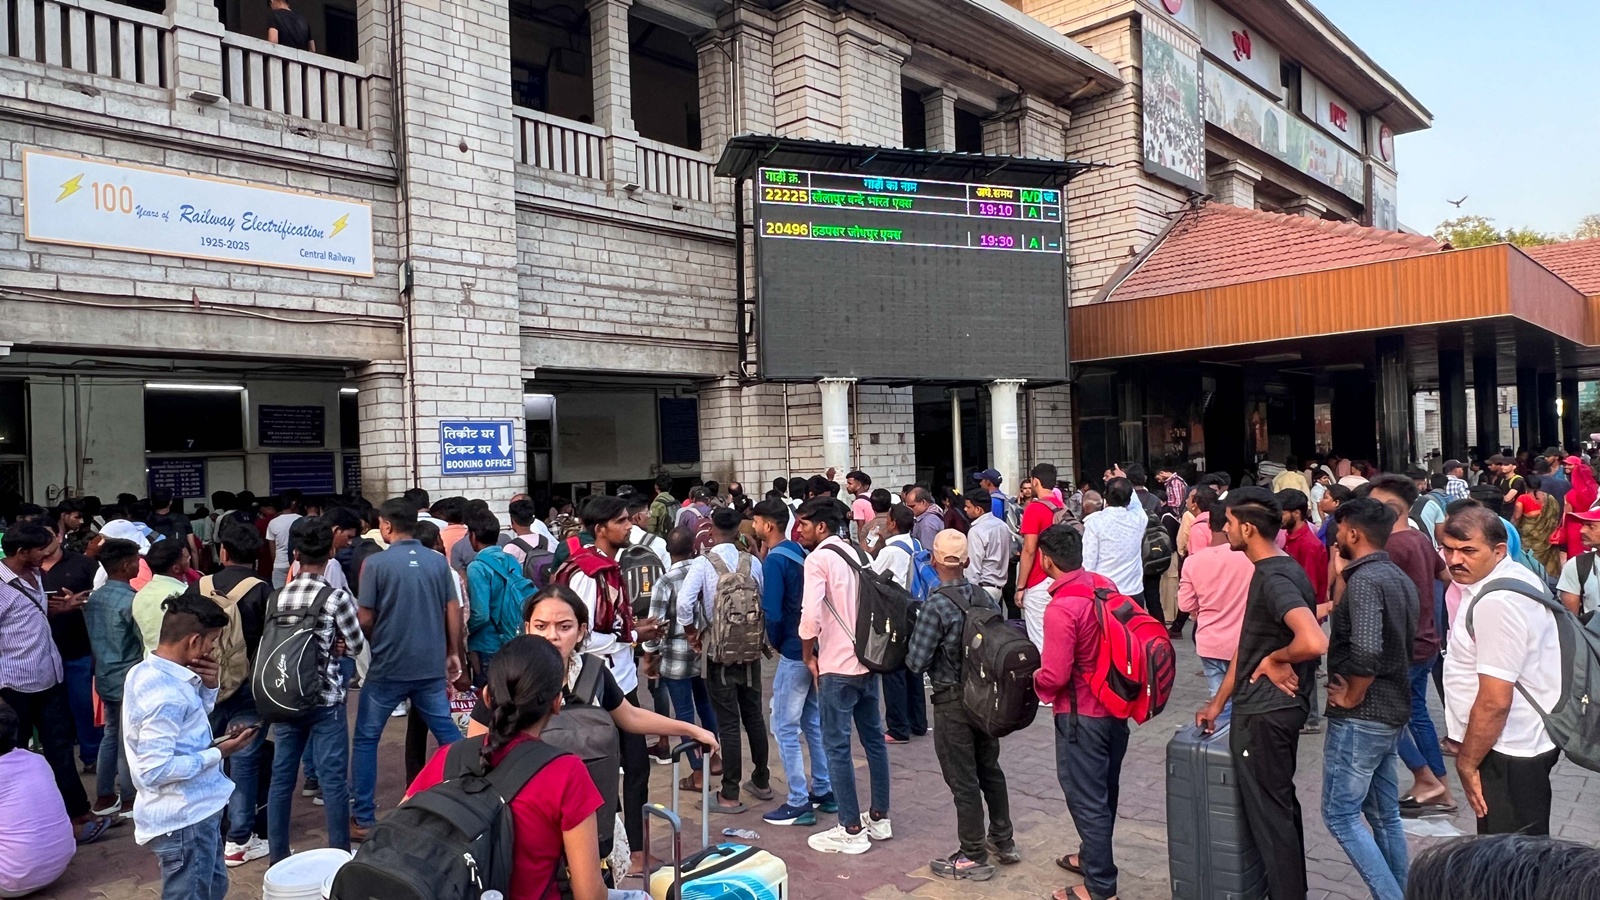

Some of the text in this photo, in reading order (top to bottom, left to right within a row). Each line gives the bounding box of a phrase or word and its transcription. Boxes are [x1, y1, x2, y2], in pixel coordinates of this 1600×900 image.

[886, 180, 898, 191] का
[900, 181, 917, 193] नाम
[765, 188, 808, 202] 22225
[1022, 190, 1041, 202] A/D
[867, 196, 890, 207] भारत
[892, 198, 913, 210] एक्स
[92, 181, 325, 240] 100 Years of Railway Electrification
[979, 204, 1013, 216] 19:10
[1028, 207, 1038, 218] A
[766, 222, 809, 235] 20496
[812, 226, 846, 237] हडपसर
[880, 230, 902, 241] एक्स
[200, 236, 250, 251] 1925-2025
[980, 235, 1014, 247] 19:30
[1029, 238, 1039, 248] A
[299, 248, 356, 265] Central Railway
[443, 426, 495, 439] तिकीट घर
[444, 442, 492, 455] टिकट घर
[446, 458, 513, 469] BOOKING OFFICE
